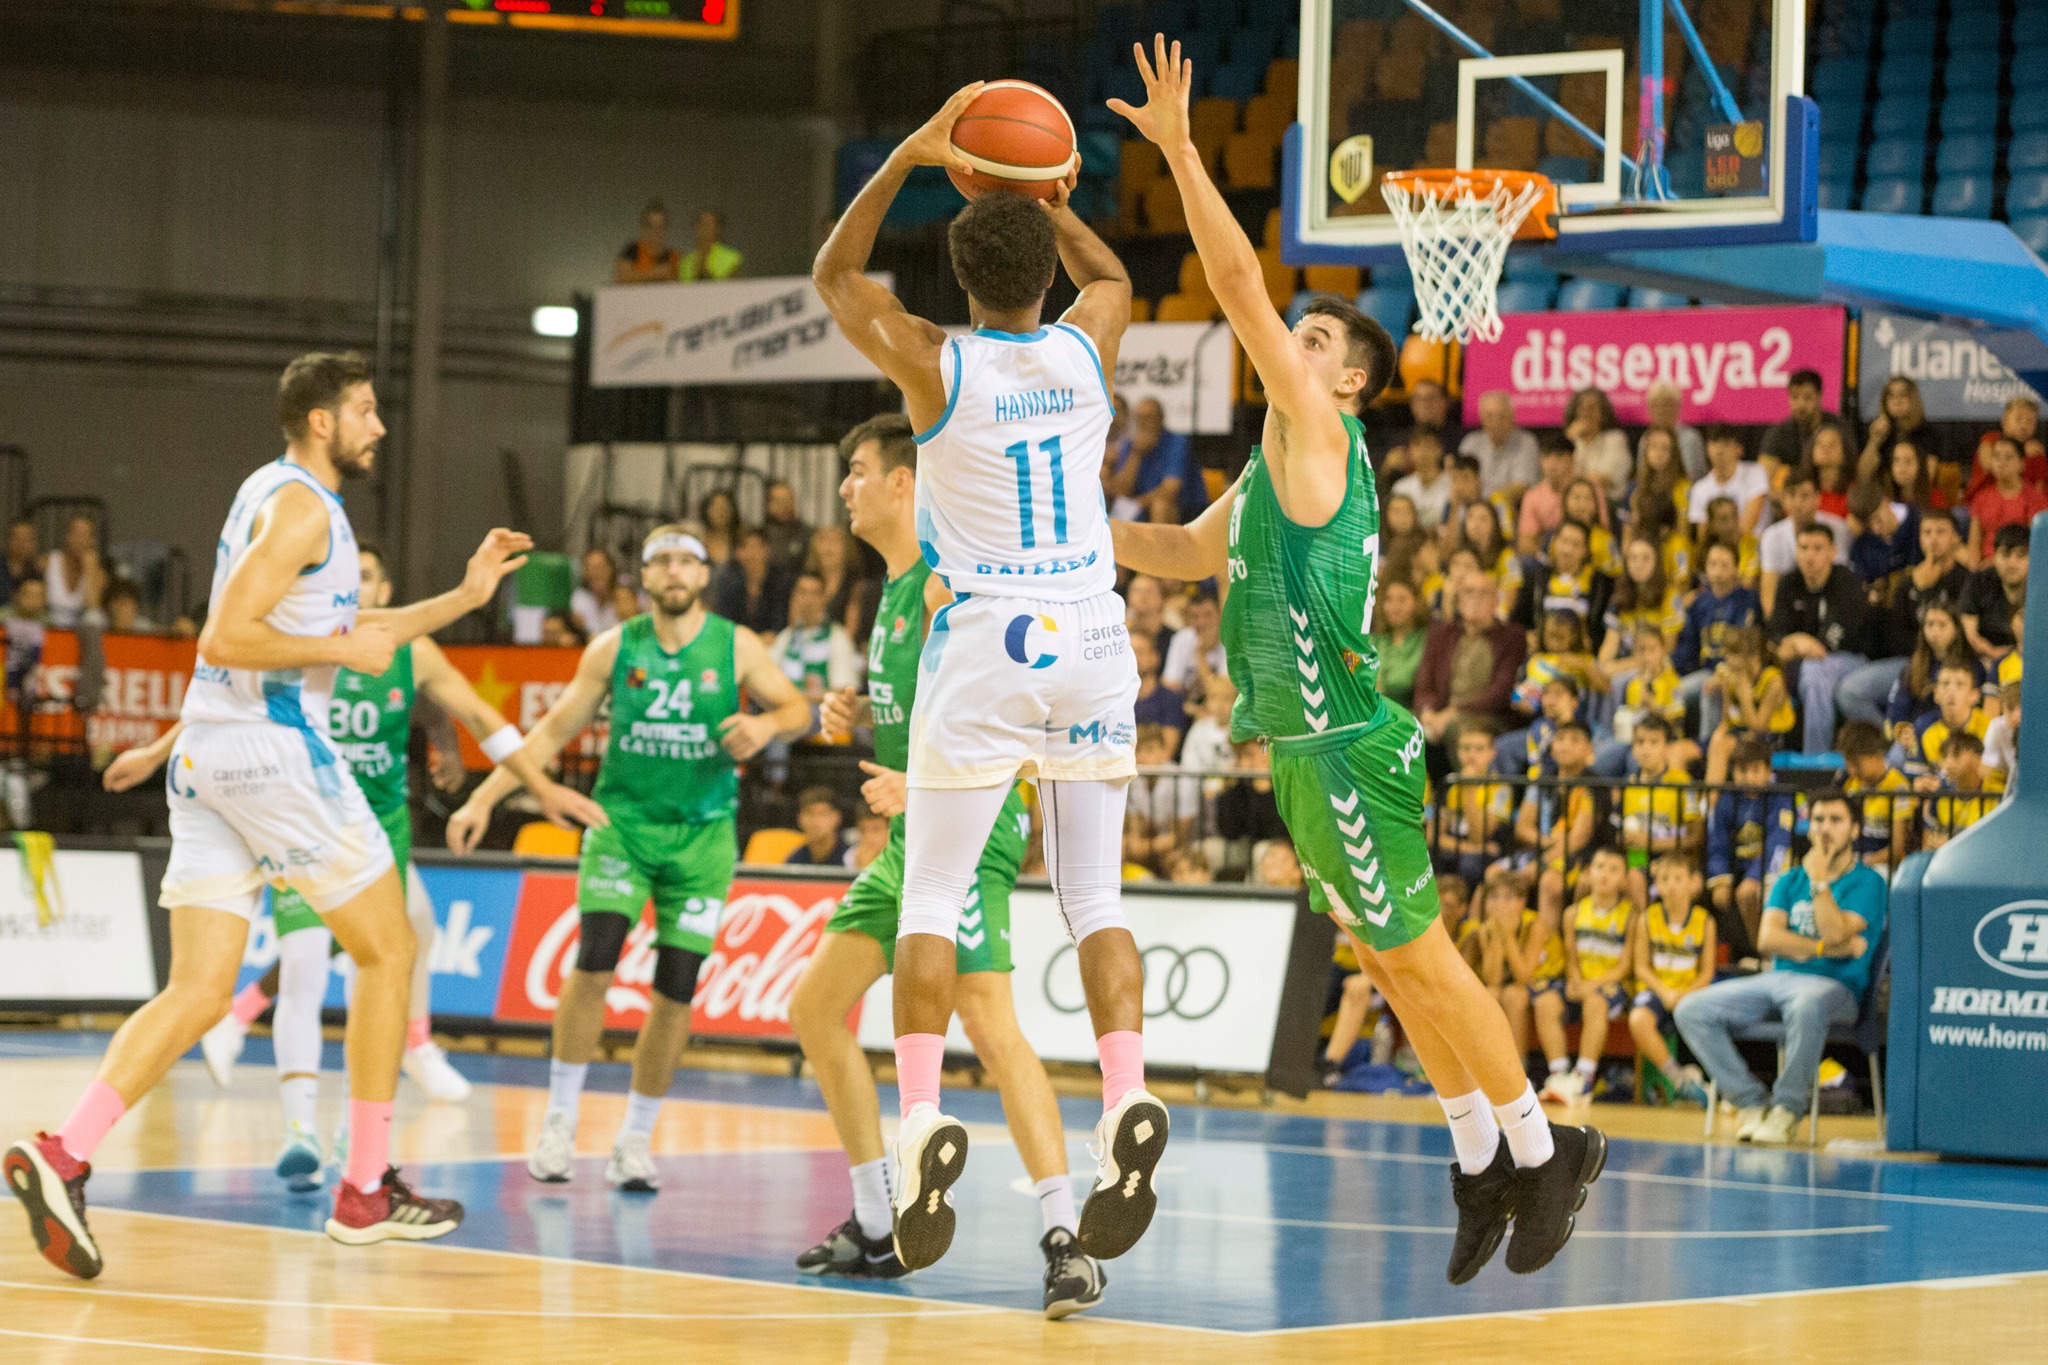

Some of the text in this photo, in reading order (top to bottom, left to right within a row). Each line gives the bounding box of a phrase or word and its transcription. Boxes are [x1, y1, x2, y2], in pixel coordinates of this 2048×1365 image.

[1511, 326, 1793, 407] dissenya2
[995, 388, 1074, 422] HANNAH
[1005, 435, 1068, 549] 11
[328, 698, 379, 738] 30
[645, 679, 694, 720] 24
[213, 764, 280, 782] carreras
[214, 780, 266, 798] center
